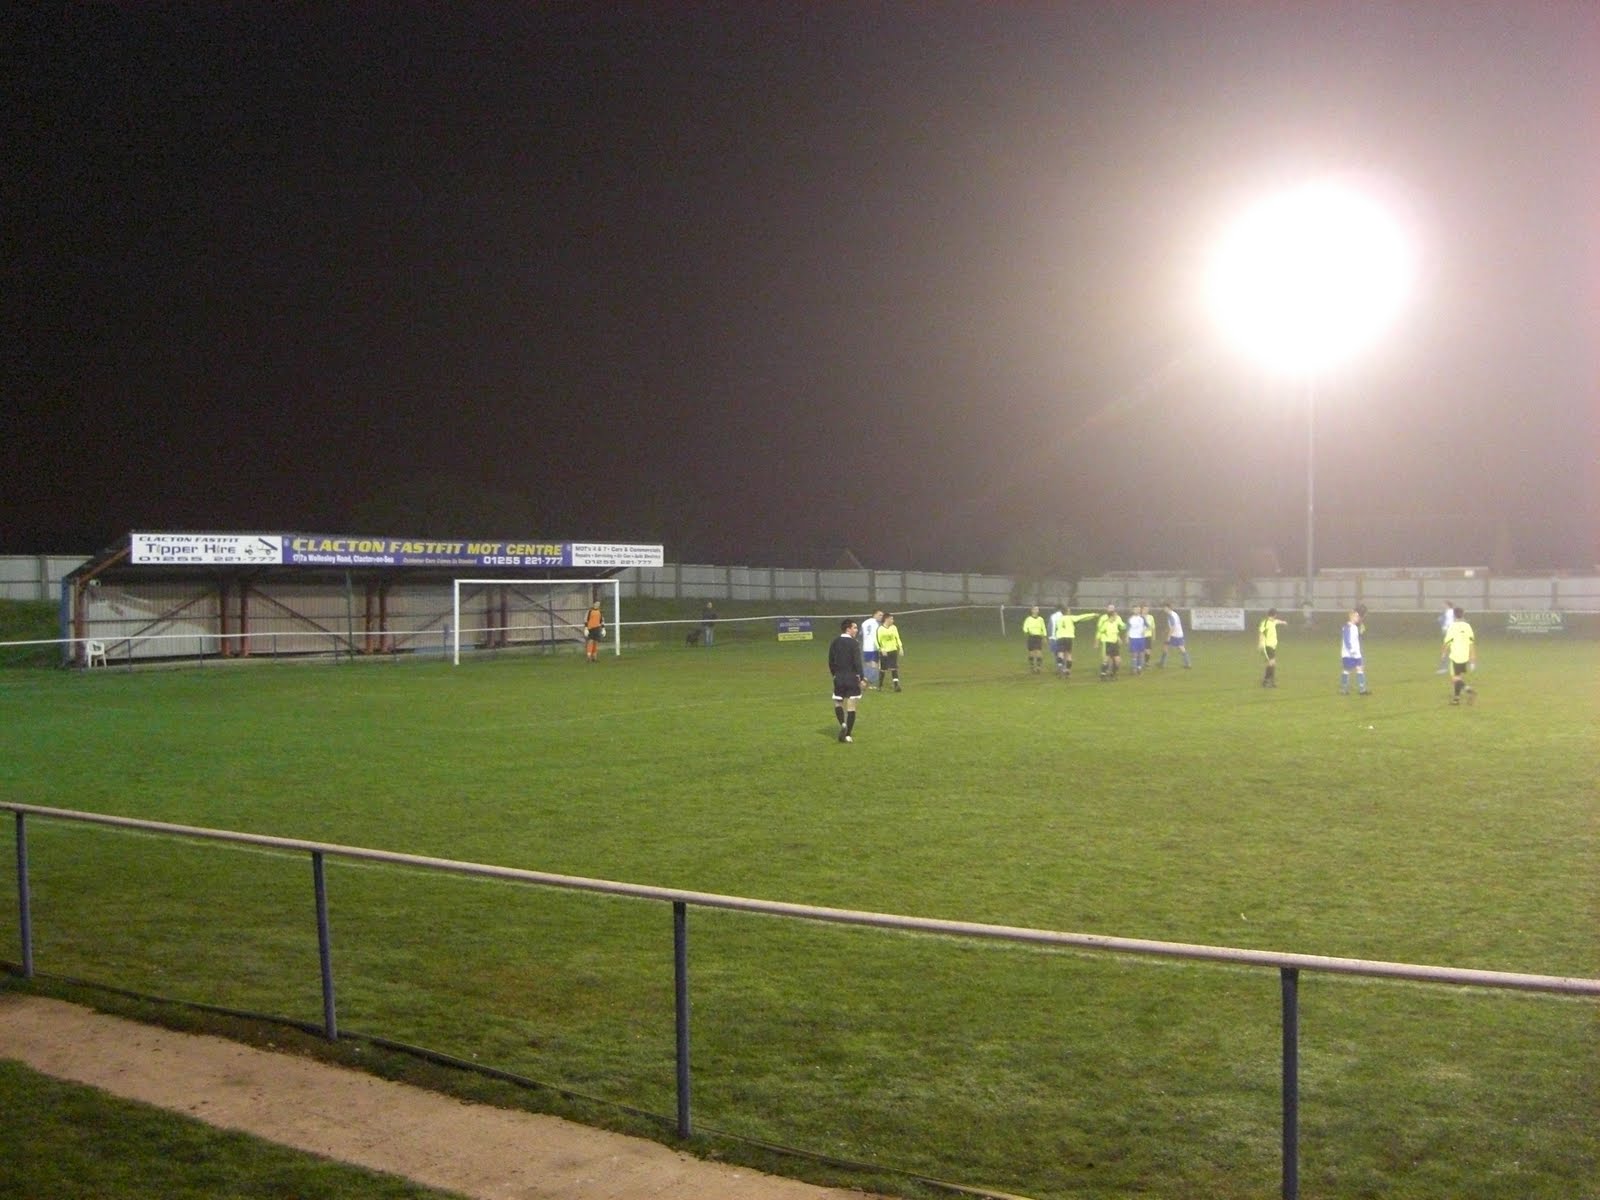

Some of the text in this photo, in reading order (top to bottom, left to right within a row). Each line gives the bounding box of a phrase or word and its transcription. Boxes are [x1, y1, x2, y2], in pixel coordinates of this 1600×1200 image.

[146, 544, 236, 555] Tipper Hire
[292, 538, 563, 556] CLACTON FASTFIT MOT CENTRE
[483, 556, 563, 565] 01255 221-777
